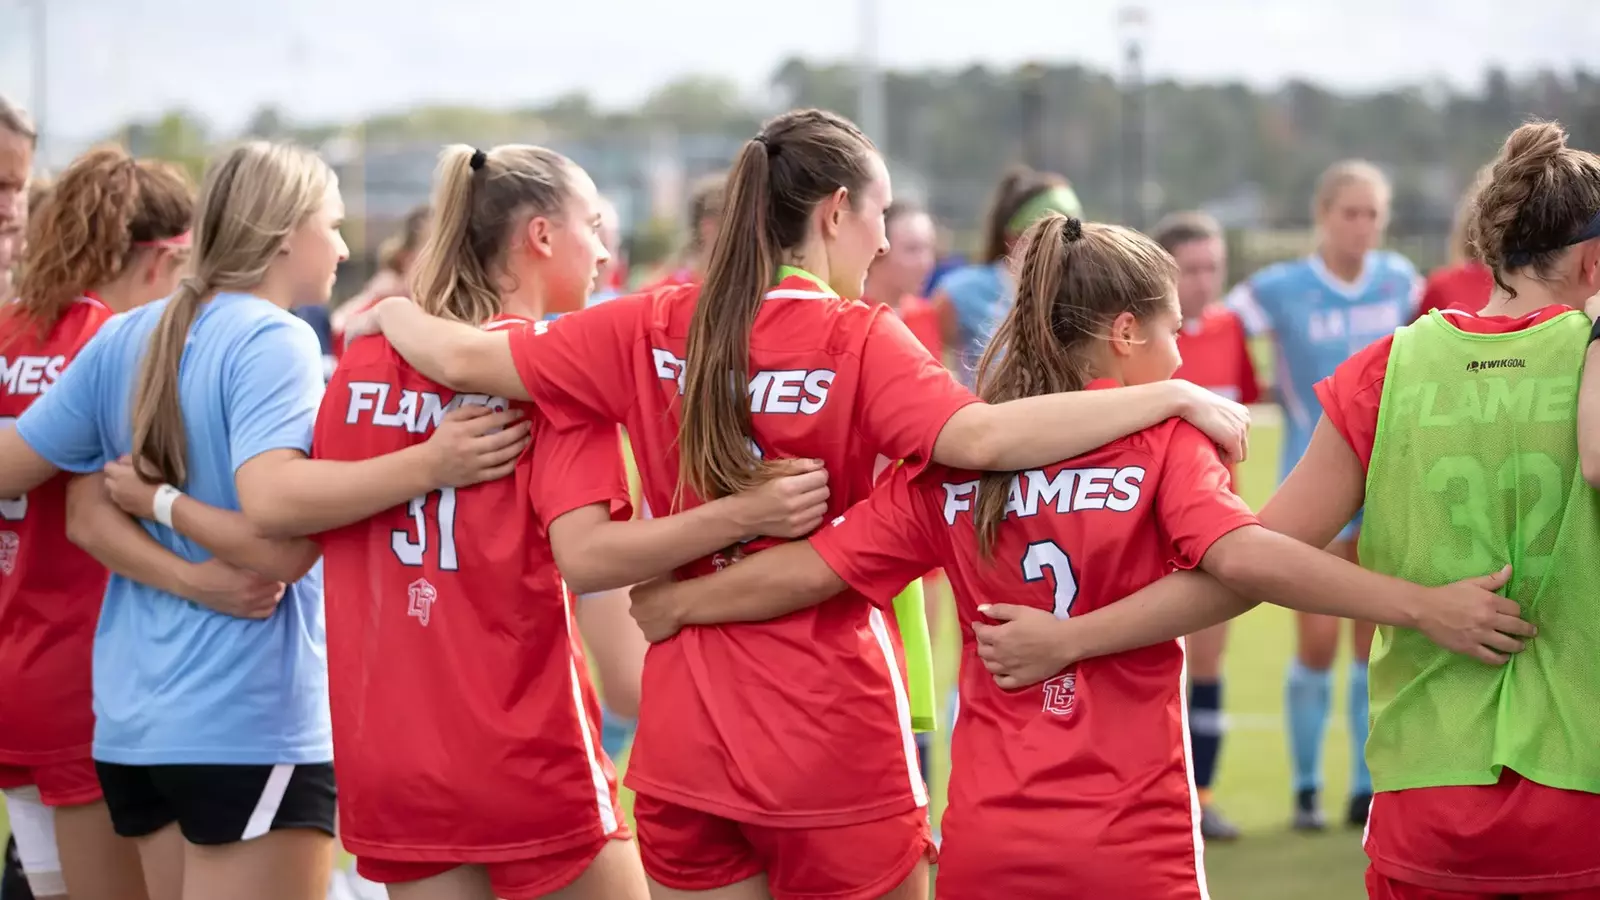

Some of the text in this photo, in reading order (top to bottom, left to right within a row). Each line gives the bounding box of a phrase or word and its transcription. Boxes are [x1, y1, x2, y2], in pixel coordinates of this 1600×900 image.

[1479, 358, 1526, 370] KWIKGOAL
[942, 465, 1146, 526] FAMES
[1424, 452, 1562, 582] 32
